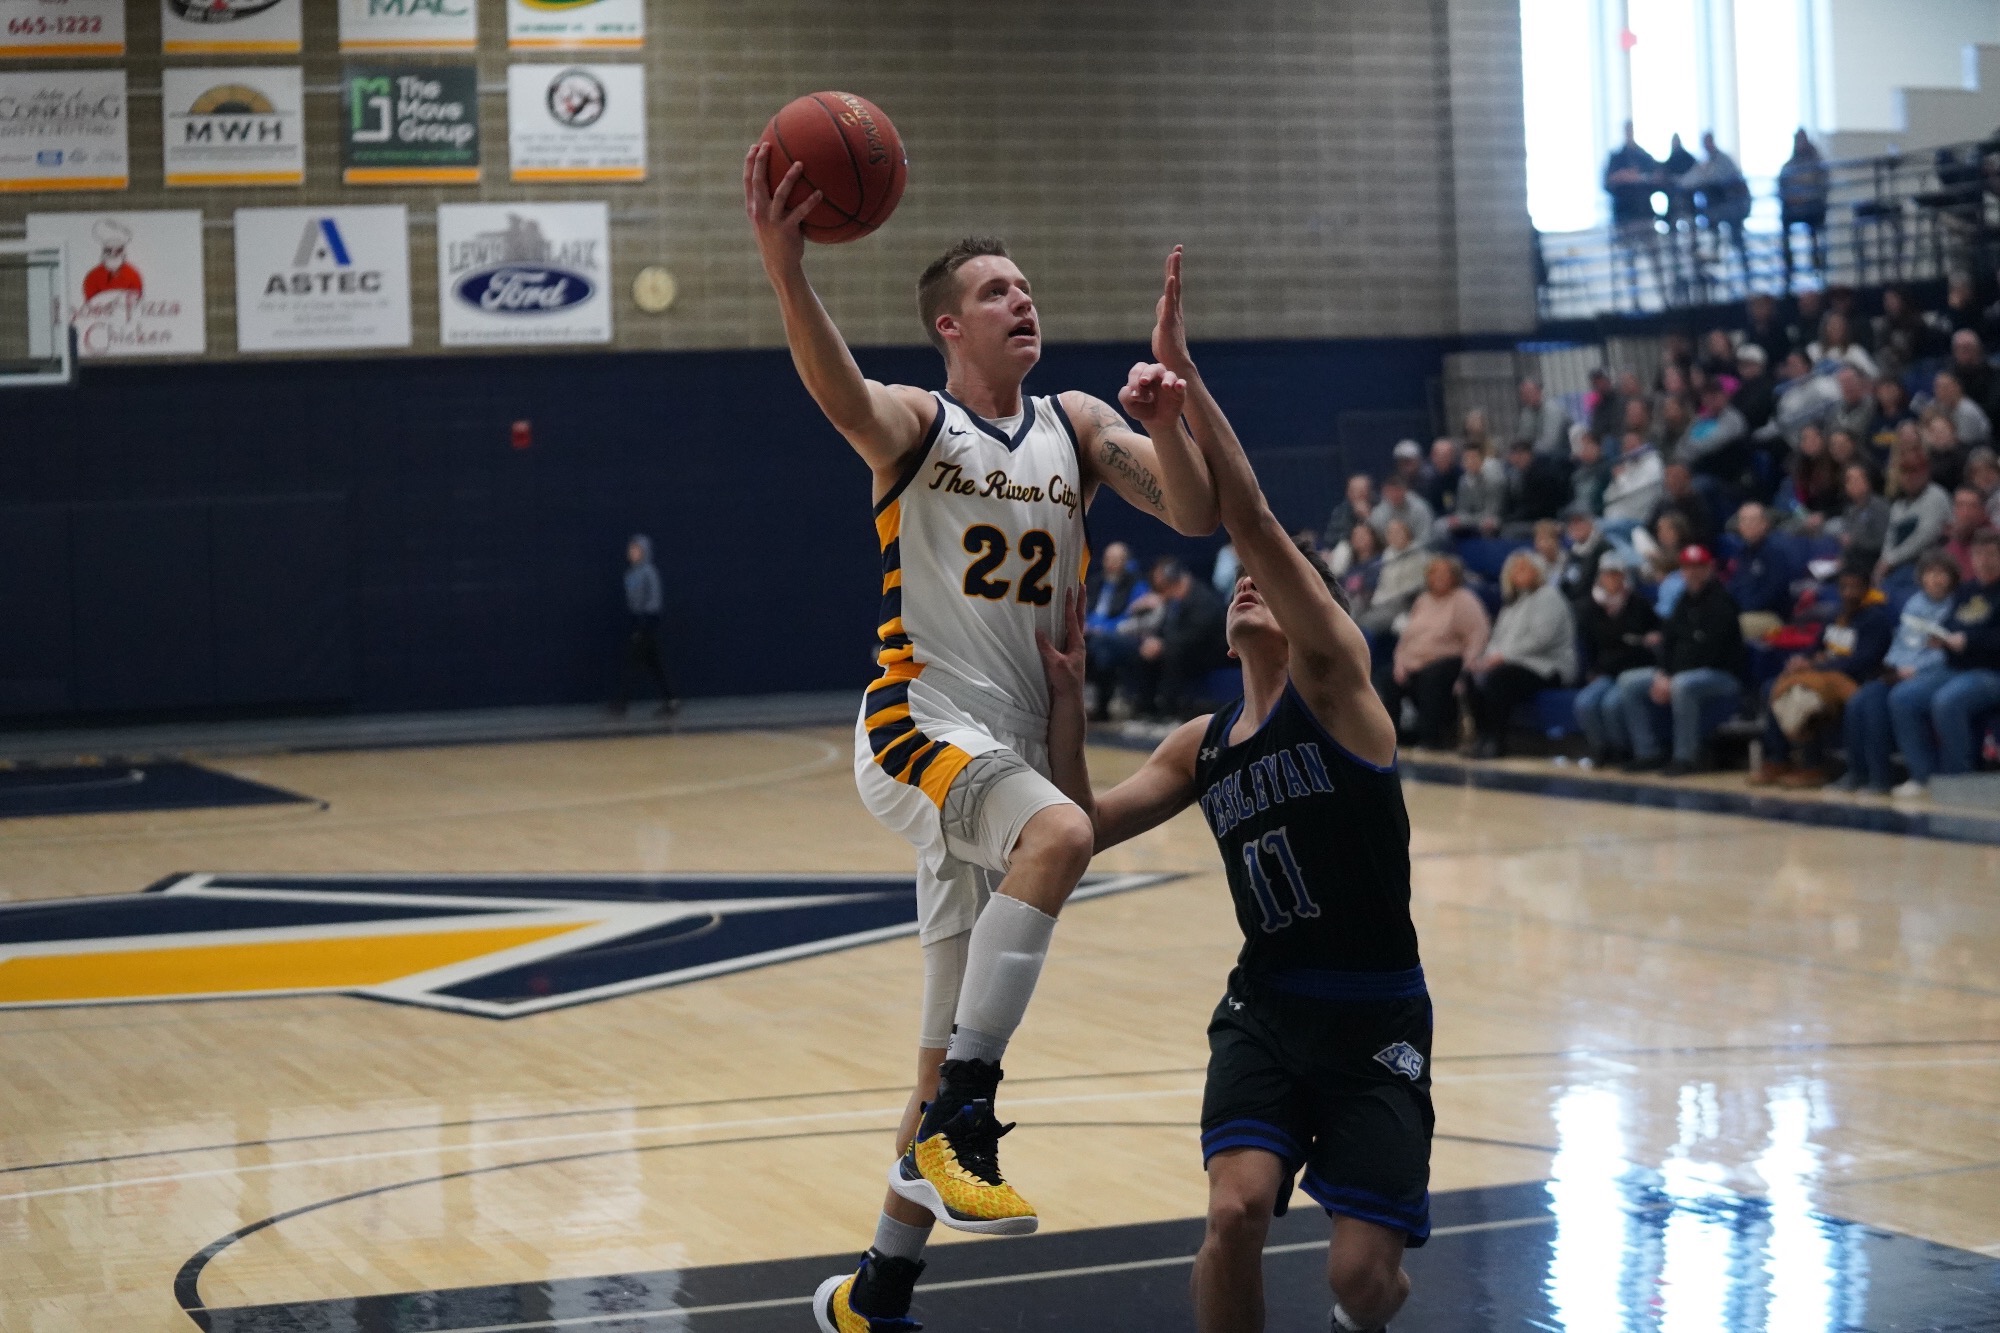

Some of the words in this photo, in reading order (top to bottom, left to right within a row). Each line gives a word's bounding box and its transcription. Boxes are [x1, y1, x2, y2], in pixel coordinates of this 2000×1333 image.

[8, 15, 103, 34] 665-1222
[396, 75, 441, 99] The
[397, 99, 463, 121] Move
[185, 120, 283, 143] MWH
[398, 118, 475, 148] Group
[263, 270, 384, 297] ASTEC
[480, 271, 570, 311] Ford
[929, 461, 976, 494] The
[980, 469, 1044, 503] River
[1048, 475, 1078, 520] City
[962, 523, 1056, 607] 22
[1201, 742, 1335, 838] ESLEYAN
[1243, 825, 1321, 934] 11
